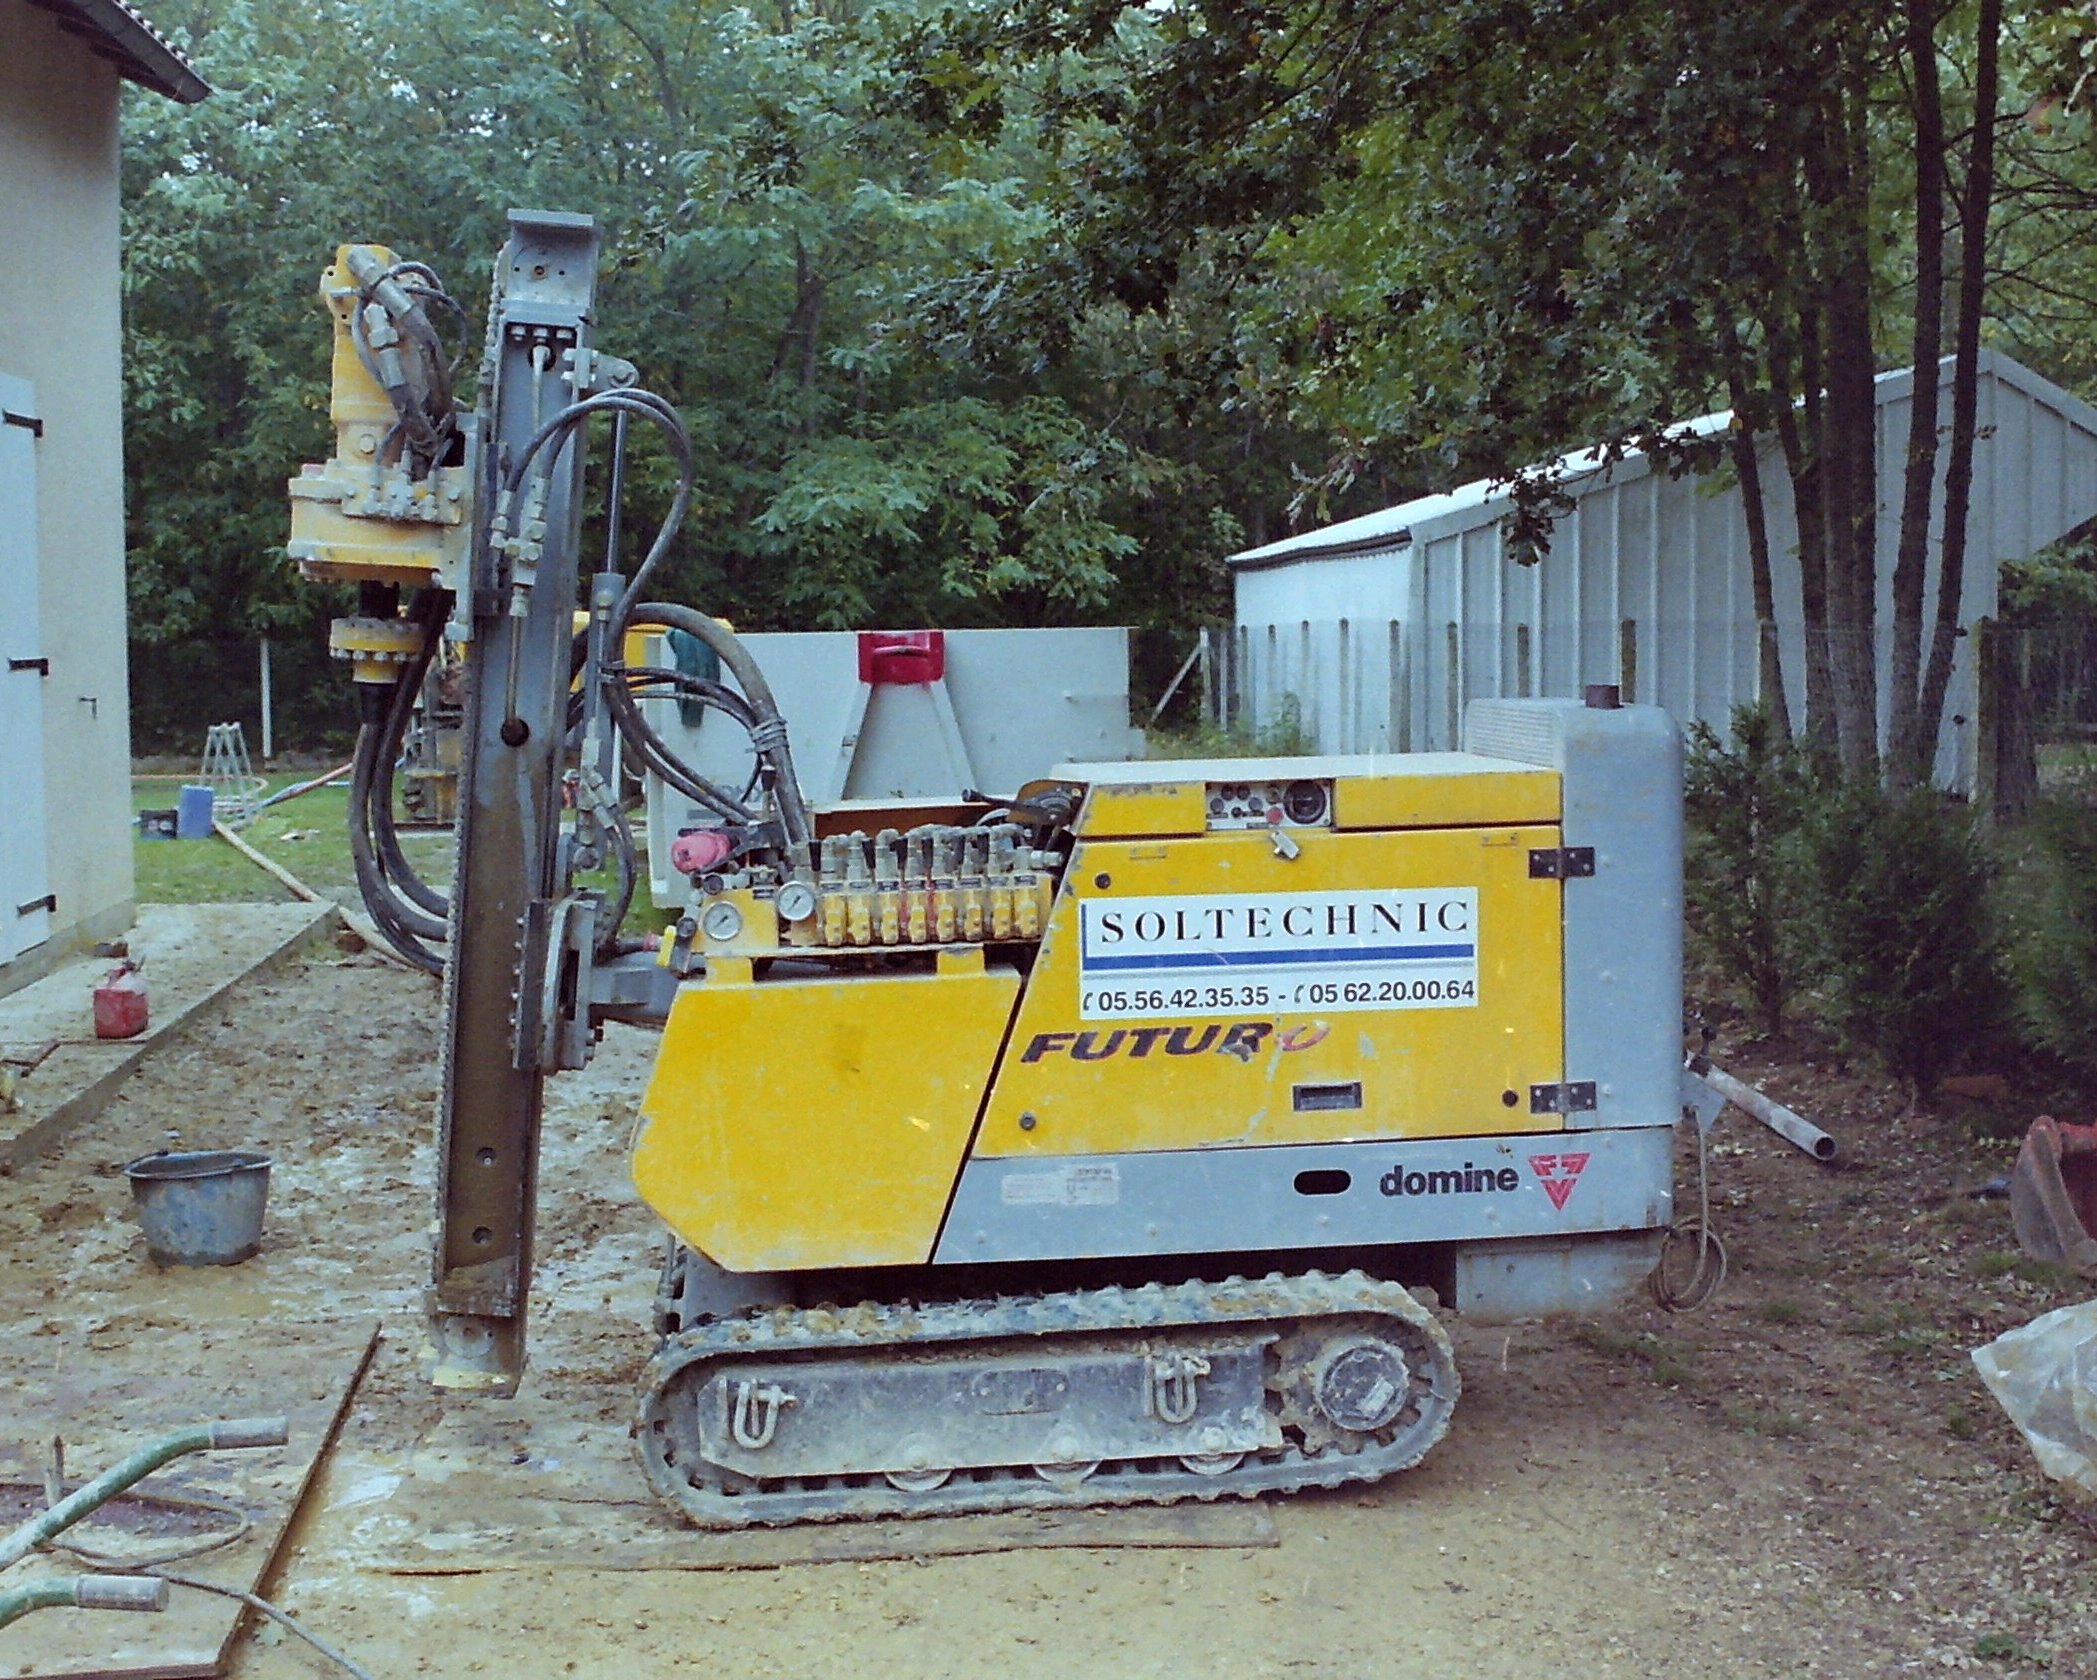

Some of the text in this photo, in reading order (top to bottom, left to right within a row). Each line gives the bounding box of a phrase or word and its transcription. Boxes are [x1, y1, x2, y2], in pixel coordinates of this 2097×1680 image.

[1100, 900, 1469, 943] SOLTECHNIC
[1098, 986, 1270, 1012] 05.56.42.35.35
[1019, 1020, 1331, 1064] FUTURO
[1379, 1161, 1520, 1197] domine
